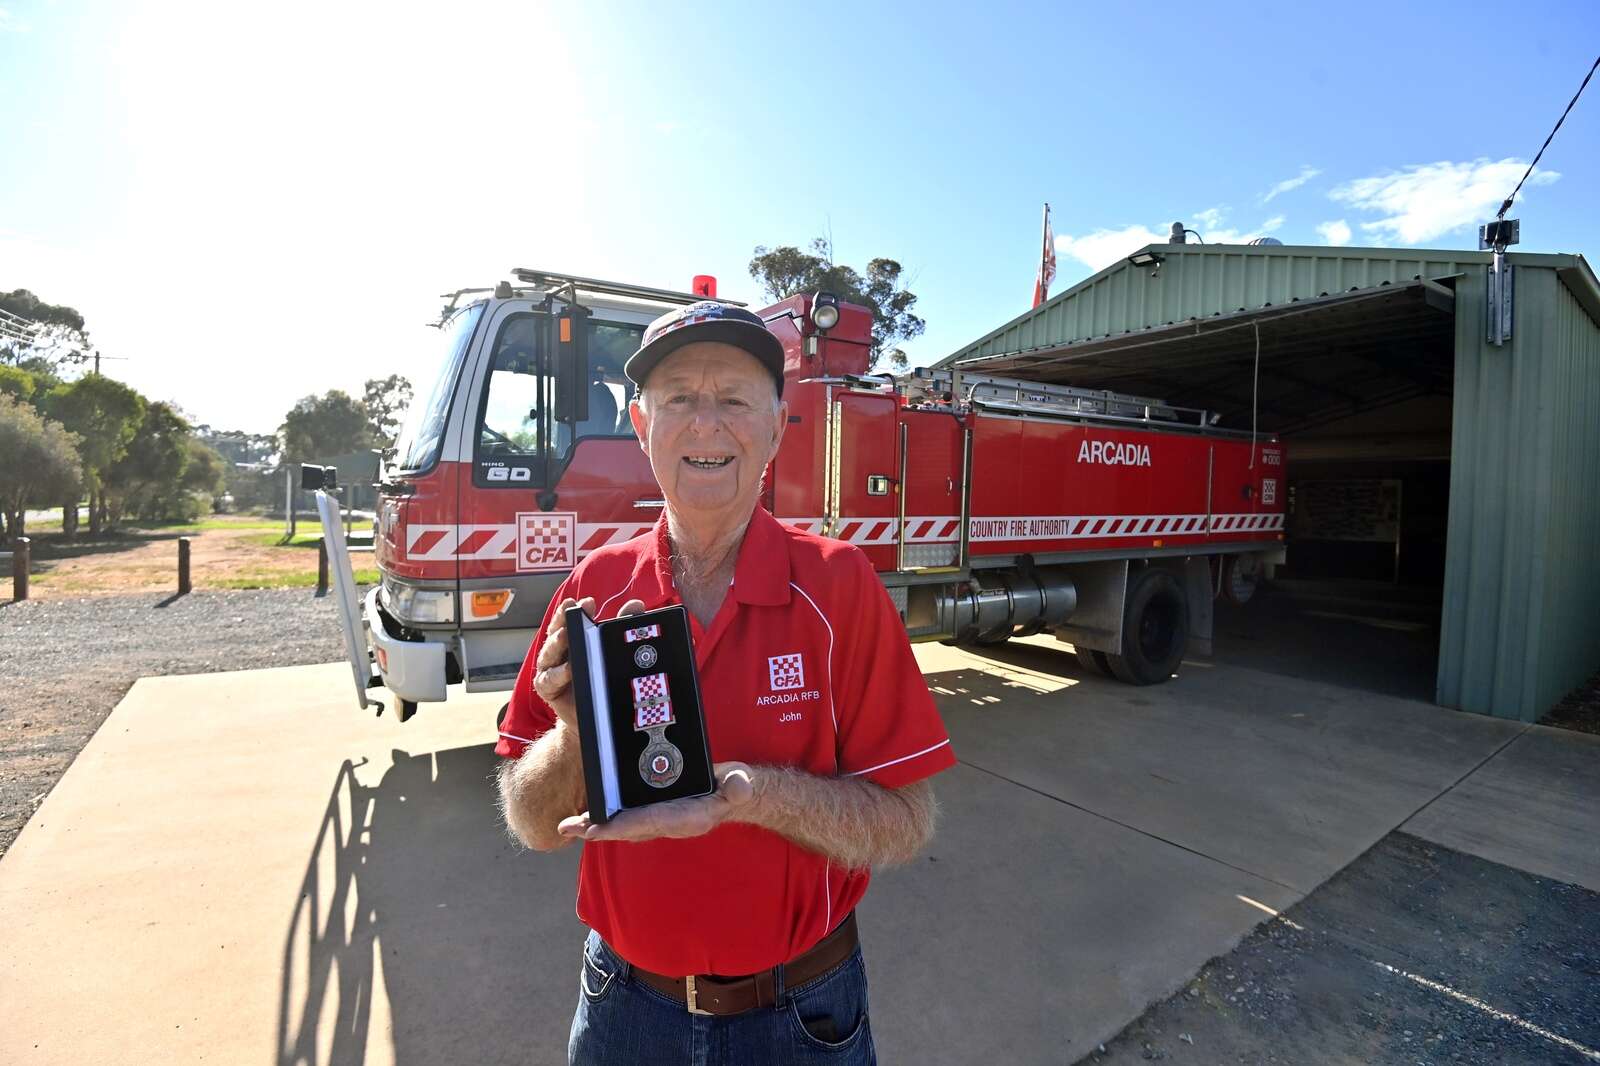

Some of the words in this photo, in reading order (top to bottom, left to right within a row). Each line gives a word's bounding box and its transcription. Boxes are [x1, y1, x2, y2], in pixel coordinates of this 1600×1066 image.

[1077, 440, 1151, 466] ARCADIA
[970, 520, 1008, 537] COUNTRY
[1010, 520, 1027, 536] FIRE
[1029, 519, 1070, 536] AUTHORITY
[525, 547, 568, 563] CFA
[774, 674, 802, 688] CFA
[756, 693, 800, 706] ARCADIA
[800, 690, 820, 701] RFB
[779, 711, 802, 722] John
